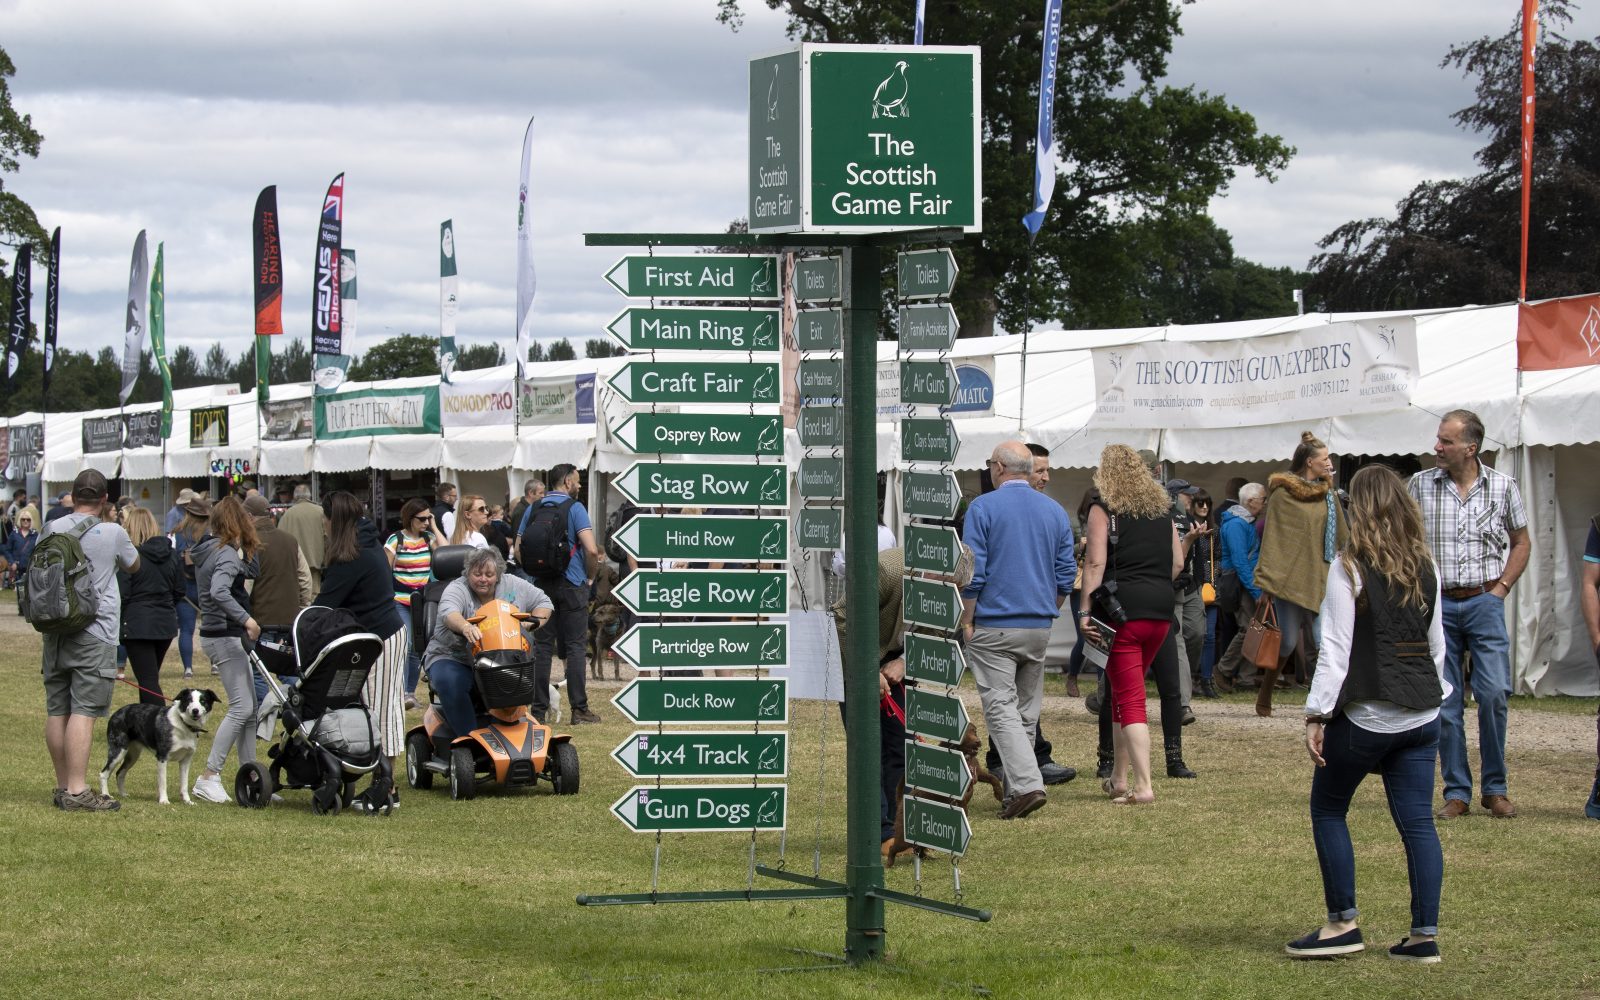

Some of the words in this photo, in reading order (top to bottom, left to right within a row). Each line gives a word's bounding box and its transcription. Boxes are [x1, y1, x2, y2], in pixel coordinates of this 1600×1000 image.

[766, 136, 781, 159] The
[868, 133, 915, 156] The
[759, 164, 788, 188] Scottish
[846, 162, 937, 186] Scottish
[755, 195, 777, 218] Game
[778, 194, 793, 216] Fair
[831, 192, 901, 215] Game
[909, 192, 953, 215] Fair
[260, 211, 268, 285] PROTECTION
[266, 212, 279, 285] HEARING
[645, 266, 693, 287] First
[698, 266, 734, 287] Aid
[803, 270, 825, 289] Toilets
[915, 264, 939, 284] Toilets
[316, 246, 332, 331] CENS
[331, 257, 340, 324] DIGITAL
[12, 266, 26, 346] HAWKE
[640, 319, 691, 340] Main
[699, 319, 744, 346] Ring
[810, 321, 822, 340] Exit
[910, 323, 925, 340] Family
[925, 321, 948, 337] Activities
[1136, 361, 1161, 385] THE
[1164, 359, 1244, 385] SCOTTISH
[1246, 354, 1285, 381] GUN
[1284, 342, 1351, 377] EXPERTS
[641, 372, 697, 393] Craft
[703, 372, 744, 393] Fair
[803, 371, 816, 386] Cash
[816, 371, 832, 385] Machines
[913, 373, 923, 393] Air
[926, 373, 945, 395] Guns
[1300, 383, 1322, 399] 01389
[1322, 379, 1350, 396] 751122
[953, 386, 989, 405] MATIC
[330, 405, 347, 430] FUR
[349, 402, 390, 427] FEATHER
[402, 399, 419, 425] FIN
[804, 418, 820, 436] Food
[821, 417, 833, 436] Hall
[654, 426, 705, 445] Osprey
[710, 427, 741, 442] Row
[914, 432, 927, 449] Clays
[928, 434, 948, 453] Sporting
[650, 473, 695, 499] Stag
[702, 474, 750, 495] Row
[802, 470, 823, 485] Woodland
[824, 471, 834, 484] Row
[912, 485, 925, 500] World
[925, 486, 931, 500] of
[931, 488, 950, 509] Gundogs
[666, 531, 699, 546] Hind
[704, 532, 735, 546] Row
[804, 519, 830, 543] Catering
[917, 537, 948, 568] Catering
[645, 582, 701, 608] Eagle
[708, 582, 756, 603] Row
[918, 592, 947, 617] Terriers
[652, 639, 715, 658] Partridge
[719, 639, 750, 653] Row
[920, 653, 951, 679] Archery
[663, 693, 700, 708] Duck
[704, 694, 735, 708] Row
[916, 704, 945, 726] Gunmakers
[945, 711, 958, 728] Row
[646, 744, 686, 765] 4x4
[693, 744, 749, 765] Track
[916, 759, 946, 781] Fishermans
[946, 766, 959, 783] Row
[645, 798, 688, 819] Gun
[697, 798, 750, 823] Dogs
[921, 813, 957, 847] Falconry
